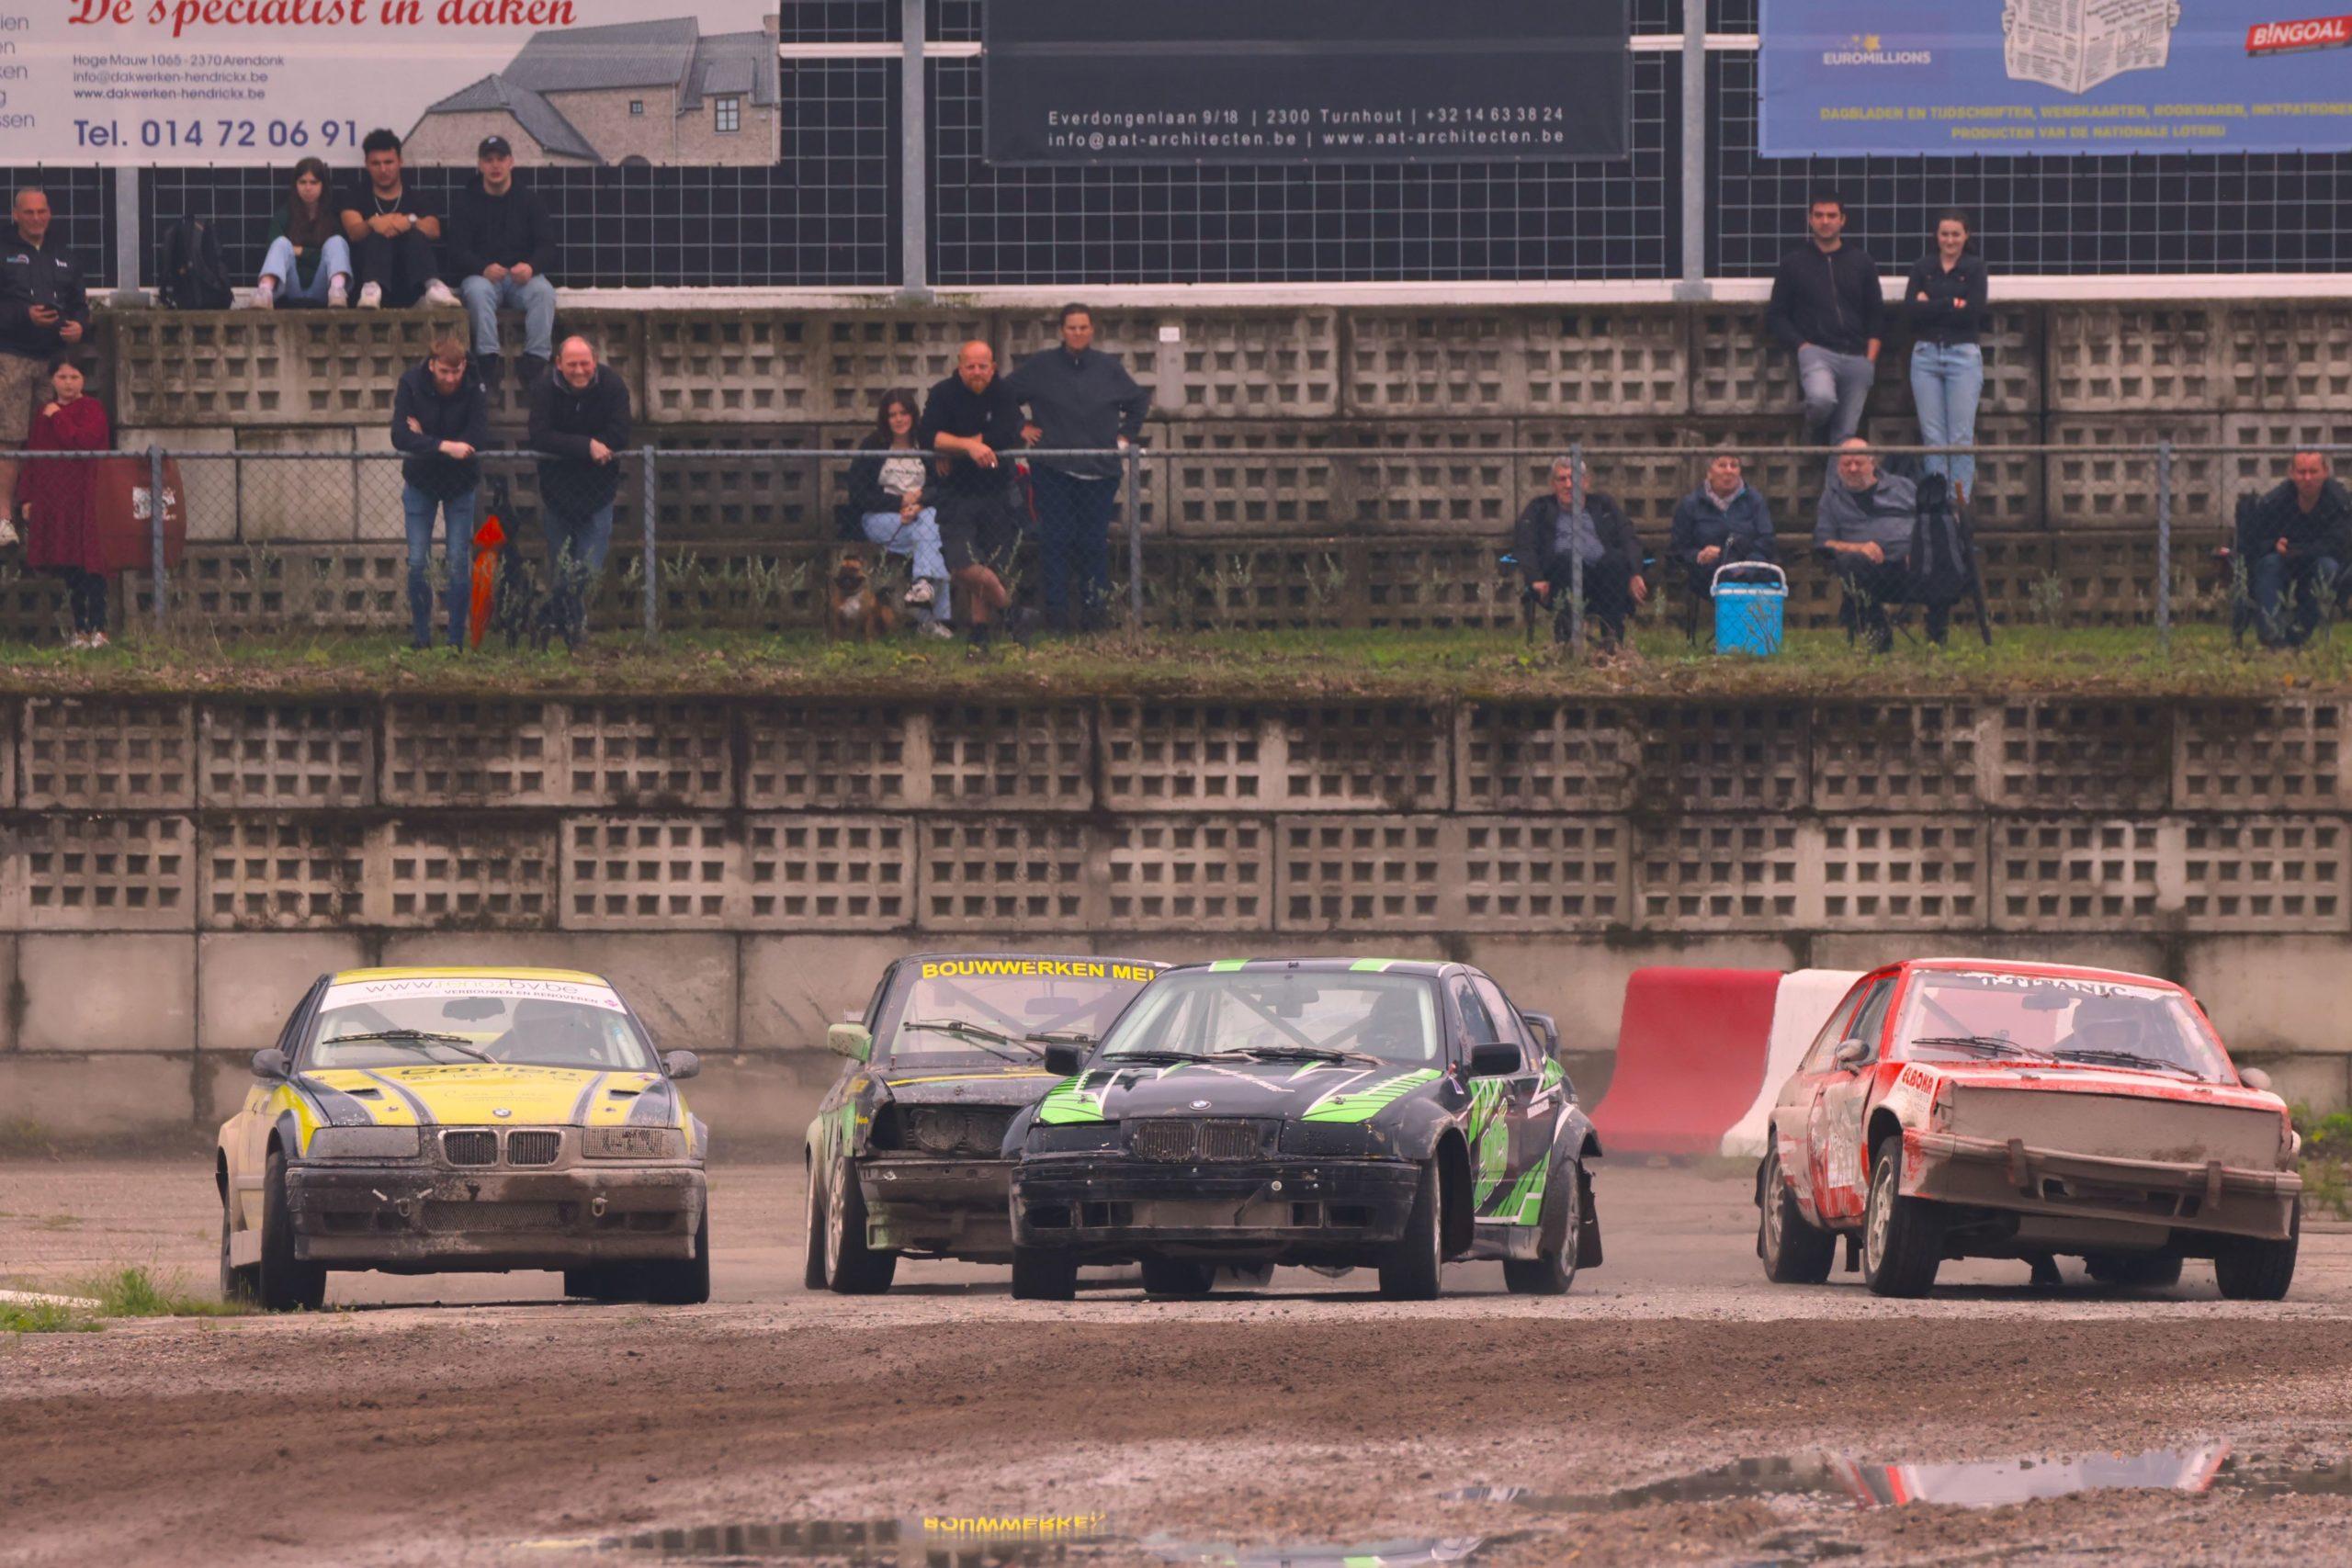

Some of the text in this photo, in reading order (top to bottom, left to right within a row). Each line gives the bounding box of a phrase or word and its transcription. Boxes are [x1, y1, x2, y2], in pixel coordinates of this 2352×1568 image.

[148, 0, 368, 38] specialist
[0, 40, 16, 54] n
[74, 55, 107, 69] Hoge
[109, 55, 148, 66] Mauw
[190, 54, 221, 66] 2370
[222, 55, 285, 67] Arendonk
[1823, 51, 1932, 65] EUROMILLIONS
[0, 64, 28, 79] en
[74, 88, 266, 99] www.dakwerken-hendrickx.be
[1048, 110, 1196, 128] Everdongenlaan
[1203, 109, 1238, 125] 9/18
[1267, 109, 1310, 125] 2300
[1319, 108, 1403, 124] Turnhout
[1427, 107, 1459, 122] +32
[1465, 107, 1484, 122] 14
[1490, 107, 1511, 122] 63
[1517, 107, 1537, 121] 38
[1544, 107, 1564, 121] 24
[1907, 107, 1927, 120] EN
[74, 119, 356, 147] Tel. 014 72 06 91
[2040, 126, 2065, 138] VAN
[2071, 126, 2088, 138] DE
[2093, 125, 2168, 138] NATIONALE
[1048, 131, 1296, 150] info@aat-architecten.be
[1322, 130, 1565, 145] www.aat-architecten.be
[922, 961, 1104, 979] BOUWWERKEN
